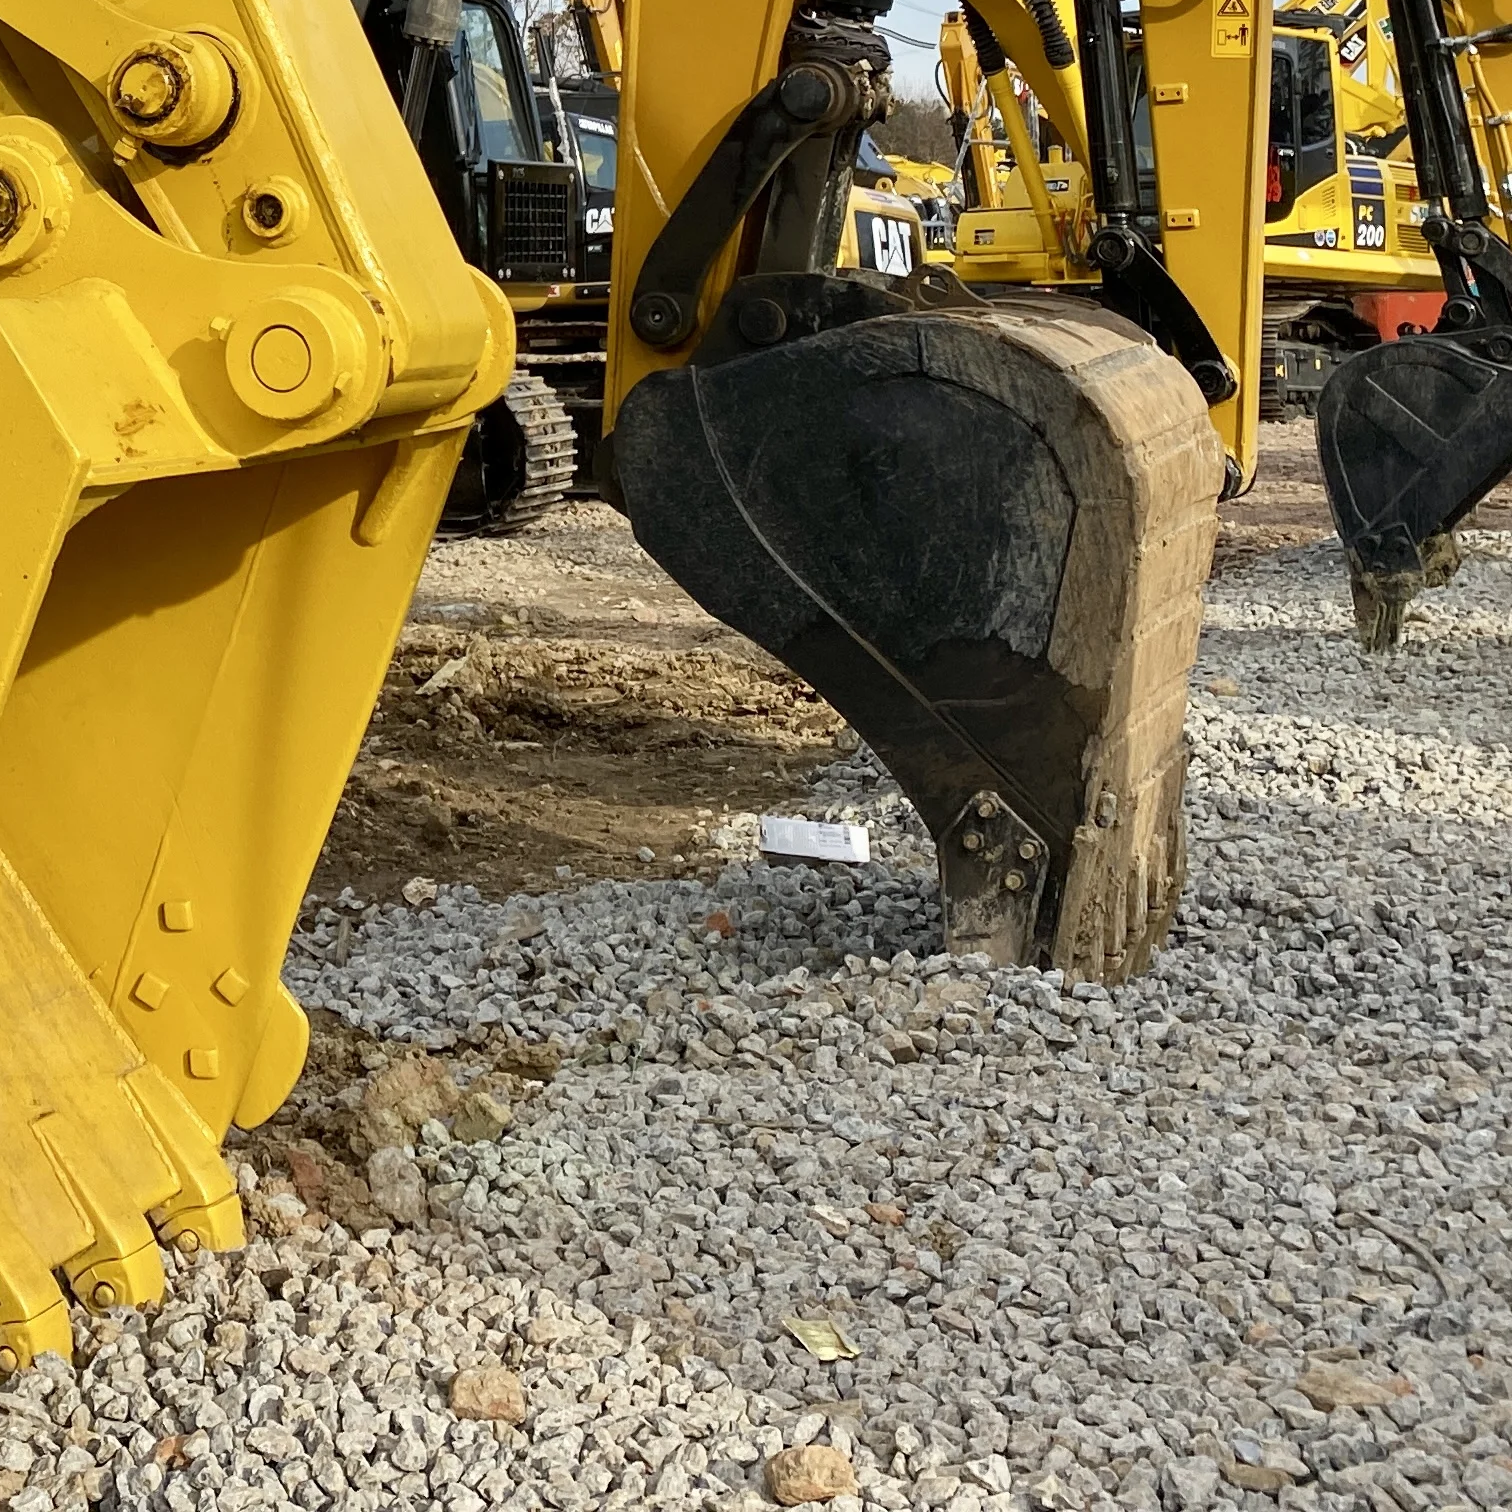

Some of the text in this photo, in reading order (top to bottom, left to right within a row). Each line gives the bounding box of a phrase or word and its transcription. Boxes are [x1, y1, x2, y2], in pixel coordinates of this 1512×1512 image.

[1341, 33, 1366, 62] CAT
[586, 207, 615, 234] CA
[1358, 204, 1375, 222] PC
[871, 216, 913, 278] CAT
[1356, 224, 1385, 248] 200
